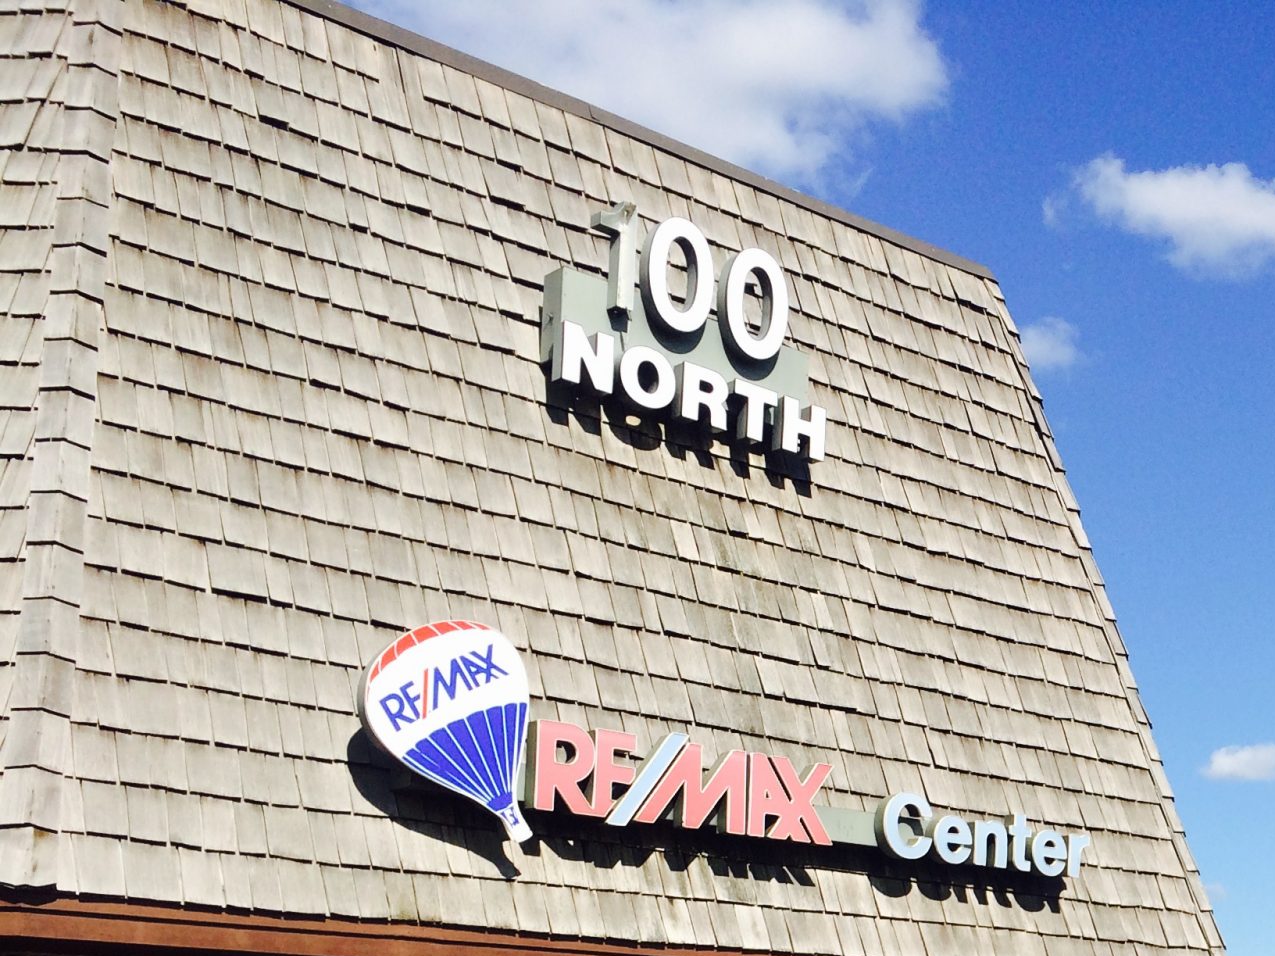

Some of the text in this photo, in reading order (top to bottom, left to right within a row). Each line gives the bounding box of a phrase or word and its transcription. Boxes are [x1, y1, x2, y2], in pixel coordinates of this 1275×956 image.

[591, 201, 789, 360] 100
[552, 320, 827, 463] NORTH
[379, 644, 510, 732] RE/MAX
[526, 719, 1091, 878] RE/MAX Center
